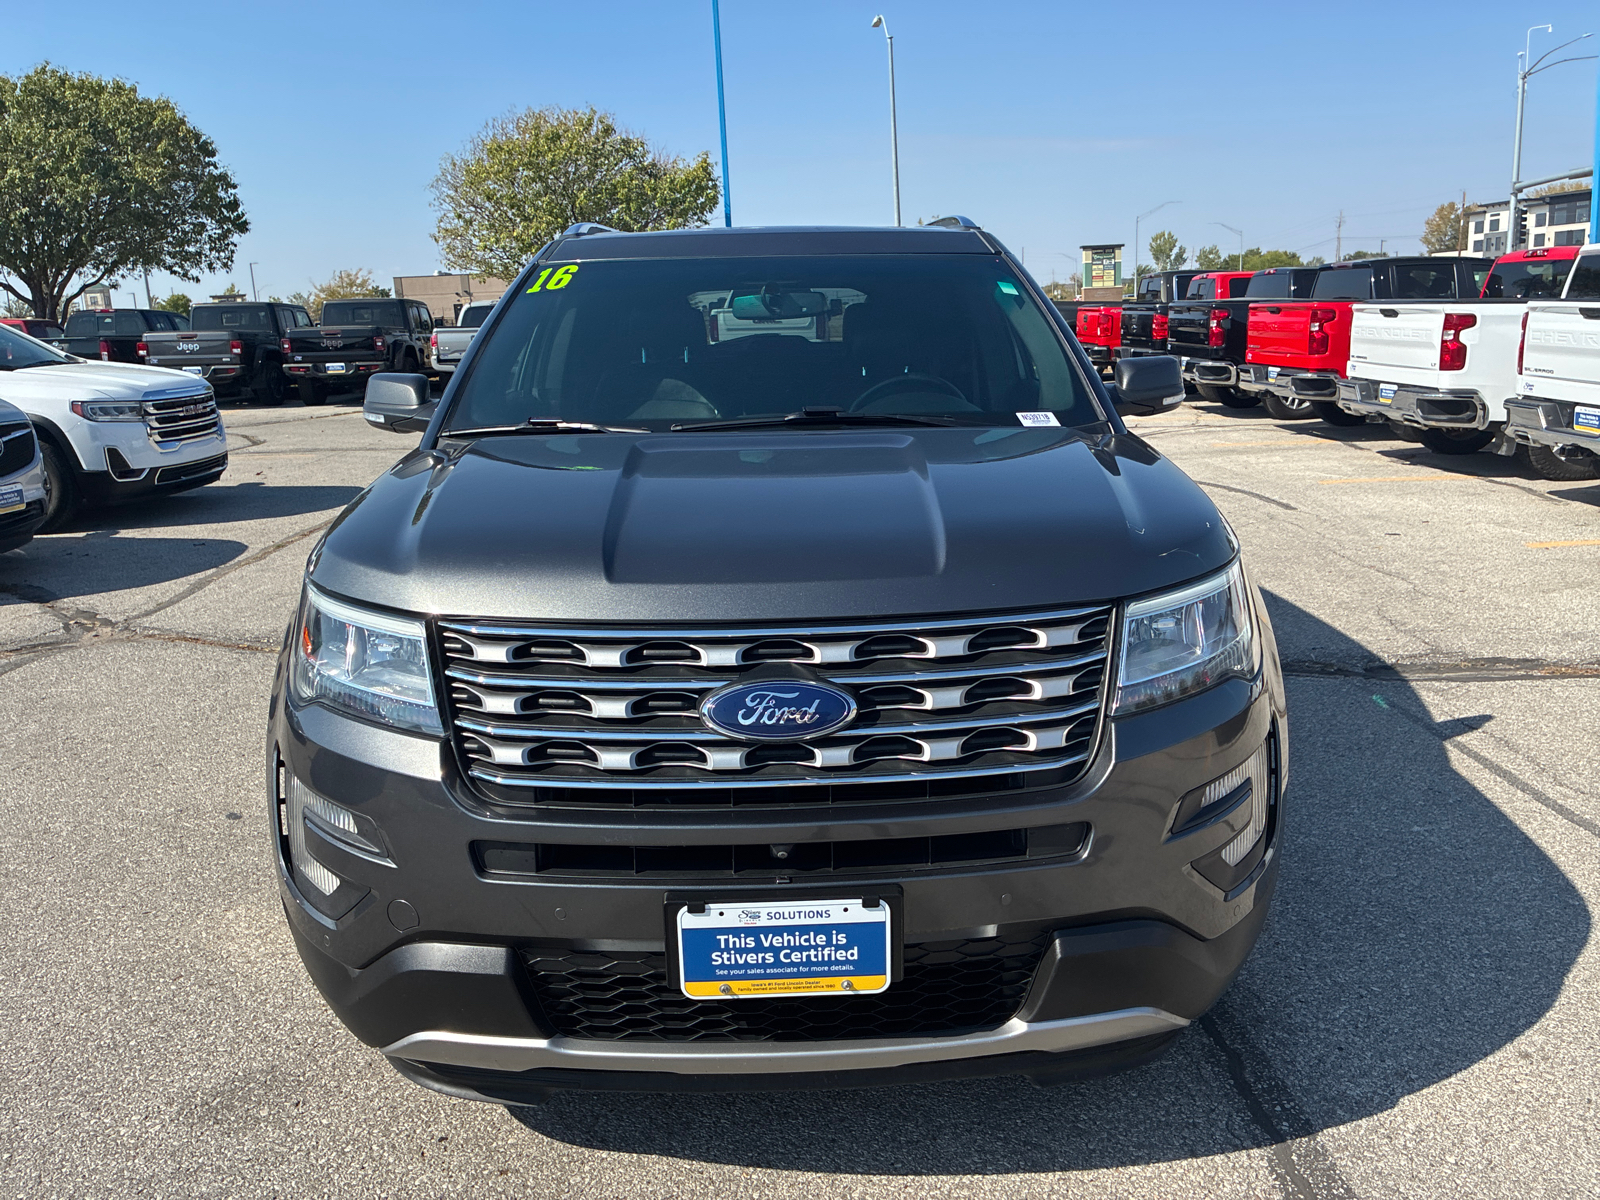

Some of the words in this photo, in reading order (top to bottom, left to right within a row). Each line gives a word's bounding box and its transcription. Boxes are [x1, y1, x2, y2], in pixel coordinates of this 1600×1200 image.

[526, 265, 579, 293] 16
[1353, 327, 1432, 338] CHEVROLET
[176, 342, 200, 351] Jeep
[320, 339, 344, 348] Jeep
[737, 691, 821, 726] Ford
[766, 909, 831, 920] SOLUTIONS
[716, 934, 755, 948] This
[760, 932, 826, 947] Vehicle
[832, 930, 847, 945] is
[711, 950, 774, 965] Stivers
[779, 946, 858, 963] Certified
[765, 966, 798, 974] associate
